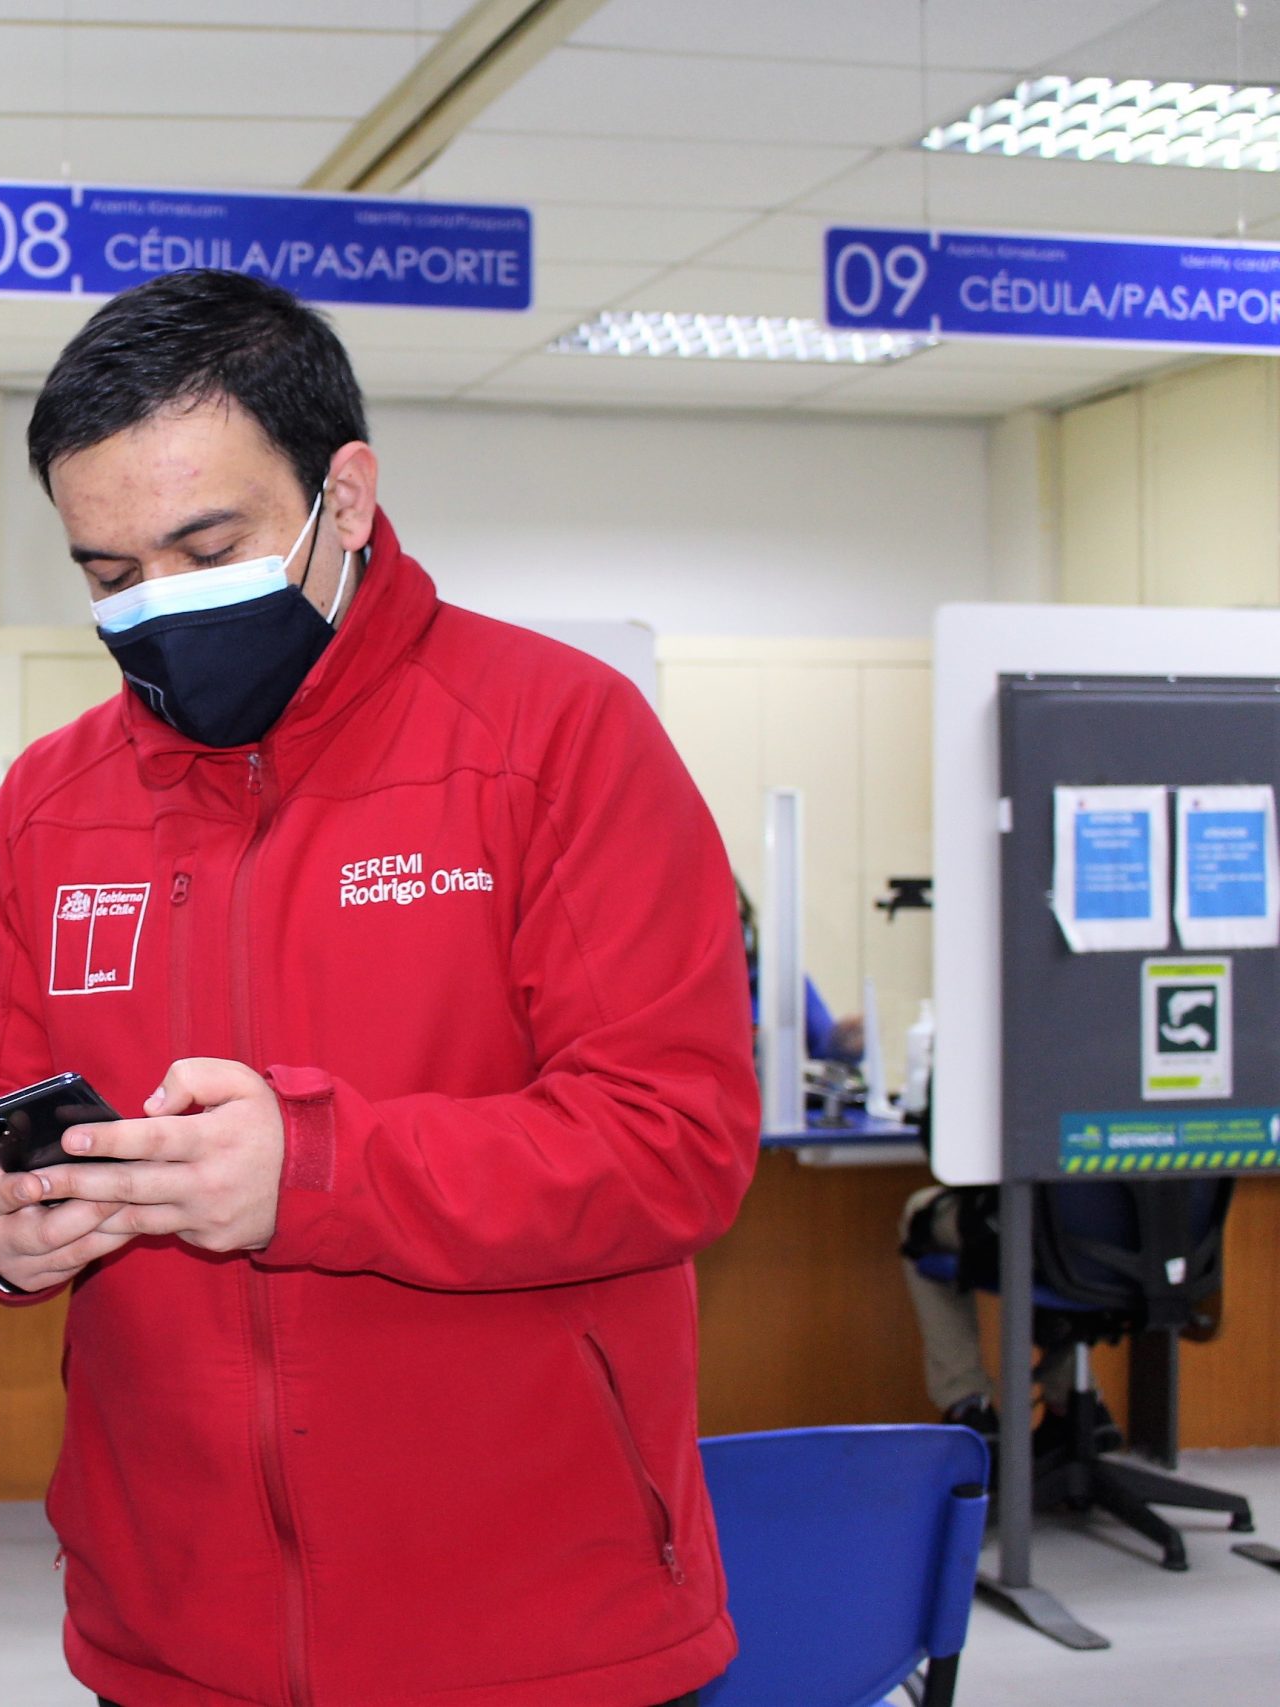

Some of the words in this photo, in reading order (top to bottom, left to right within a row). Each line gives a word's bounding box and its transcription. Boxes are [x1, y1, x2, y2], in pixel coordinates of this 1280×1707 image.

[103, 226, 519, 287] CÉDULA/PASAPORTE
[833, 242, 928, 318] 09
[339, 852, 423, 885] SEREMI
[340, 877, 426, 908] Rodrigo
[109, 903, 135, 916] Chile
